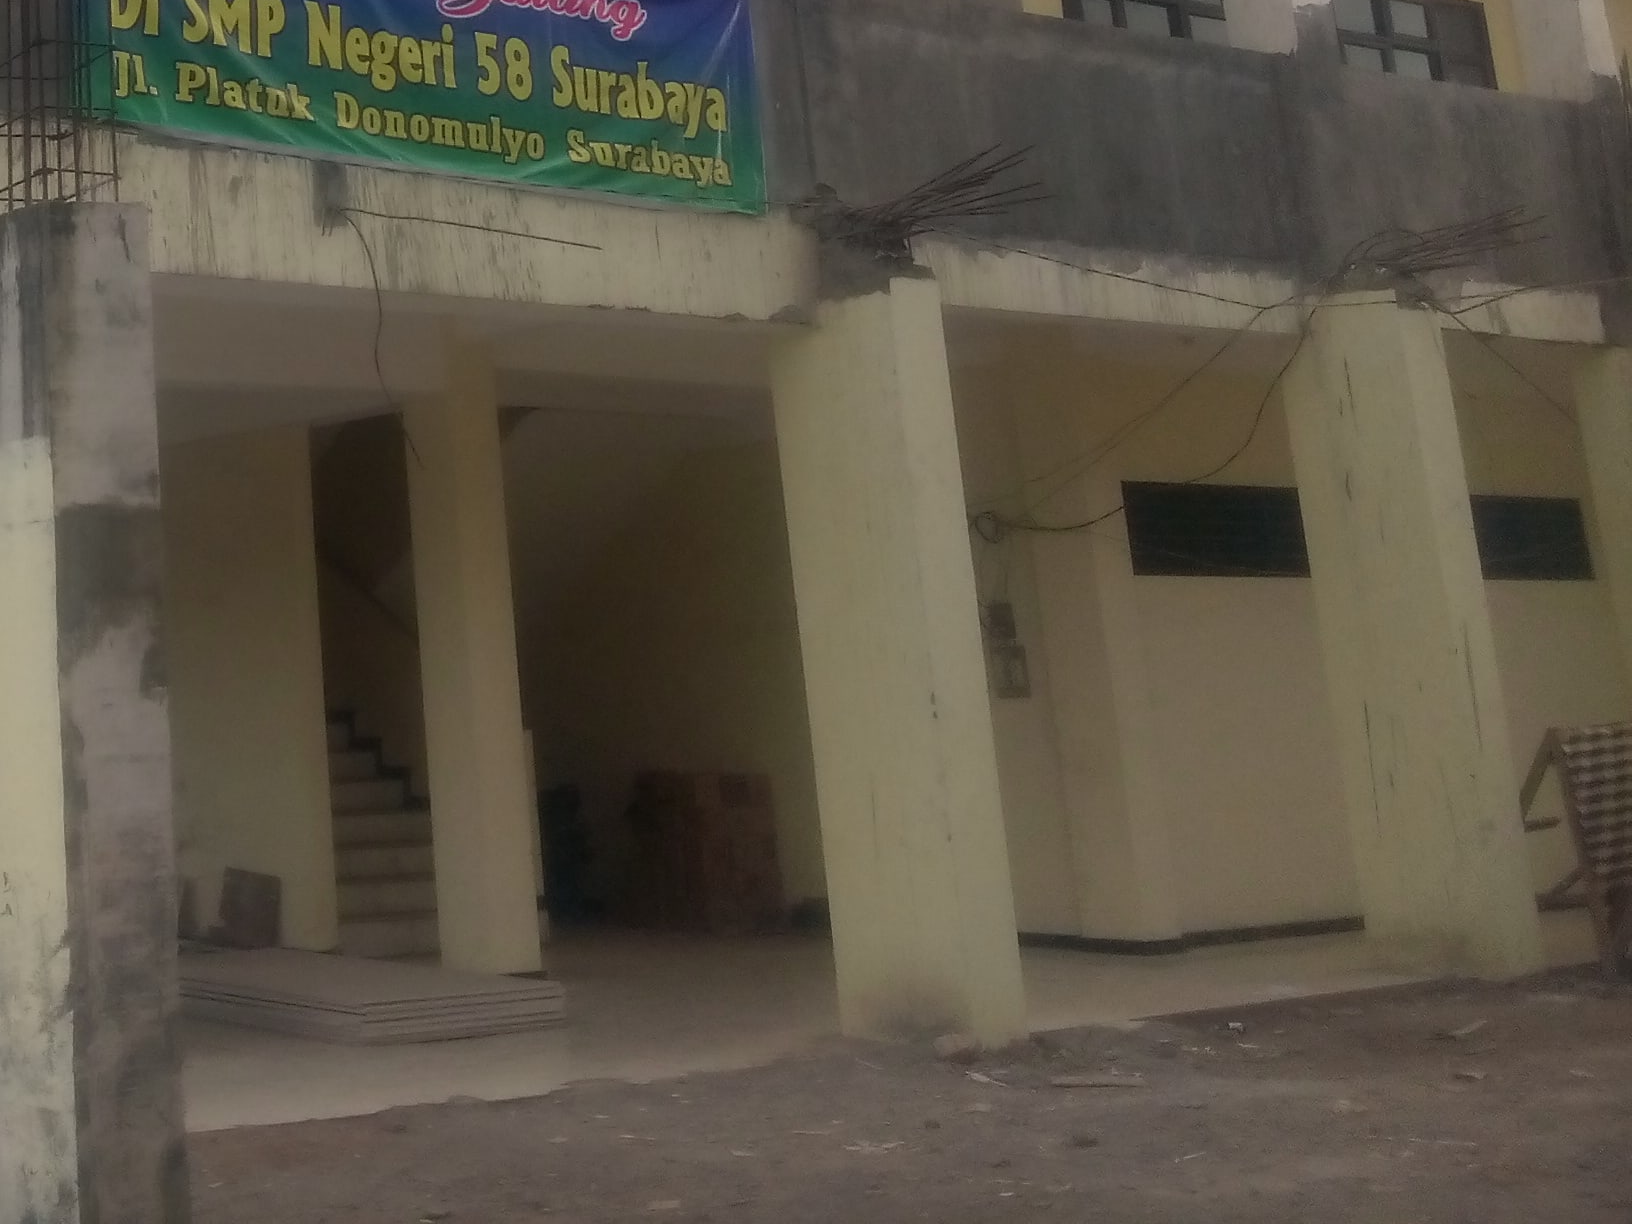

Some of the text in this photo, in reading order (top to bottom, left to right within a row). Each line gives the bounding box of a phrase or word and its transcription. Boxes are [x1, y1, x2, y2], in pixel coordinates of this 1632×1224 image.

[114, 51, 733, 188] Jl. Platuk Donomulyo Surabaya
[306, 0, 456, 90] Negeri
[475, 31, 532, 101] 58
[552, 46, 726, 138] Surabaya
